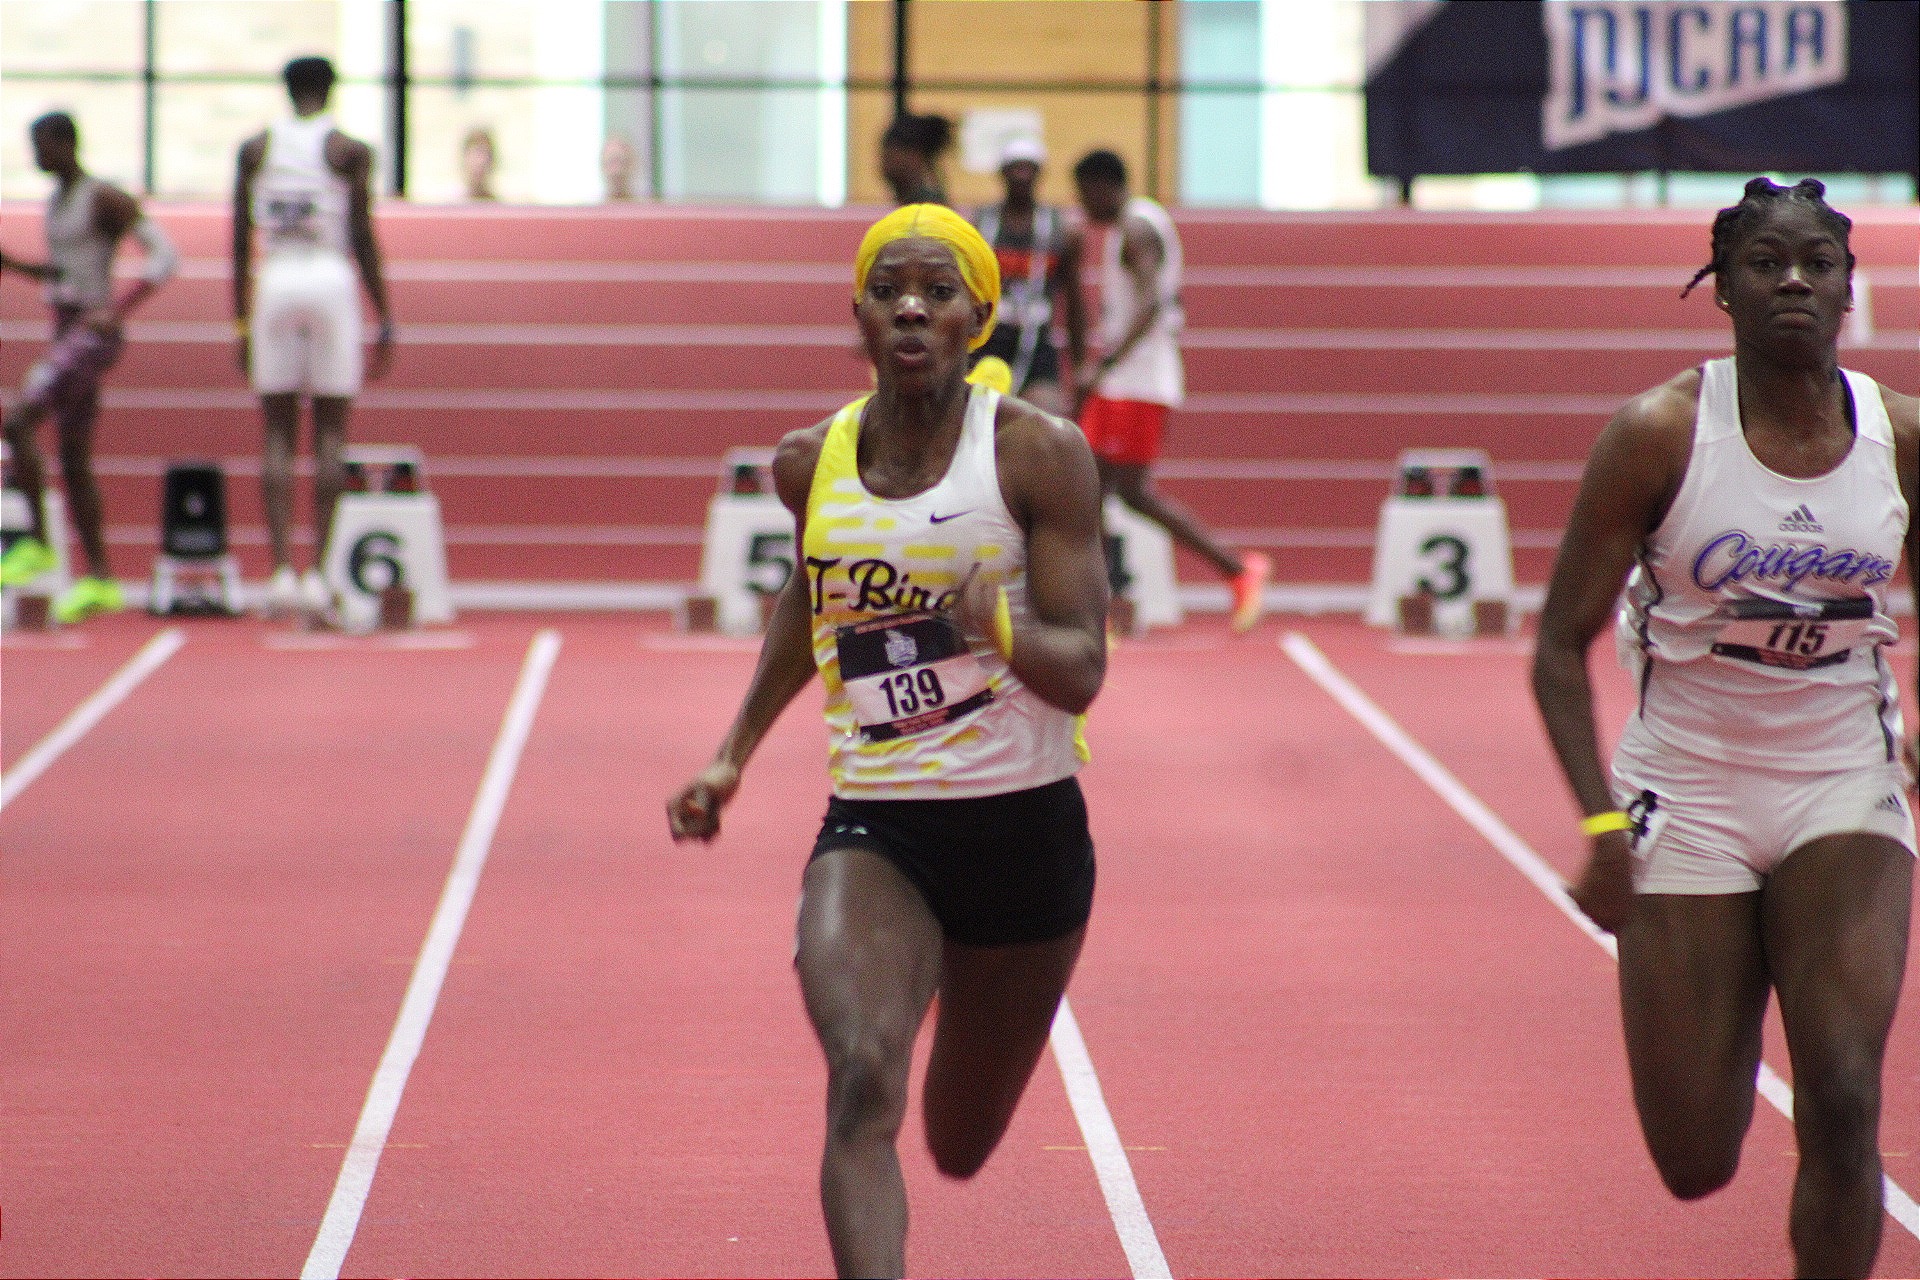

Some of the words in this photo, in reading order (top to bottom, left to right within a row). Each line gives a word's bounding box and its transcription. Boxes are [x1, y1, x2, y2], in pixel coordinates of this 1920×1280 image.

[1569, 2, 1824, 121] NJCAA
[1778, 523, 1824, 533] adidas
[350, 529, 405, 596] 6
[745, 533, 793, 595] 5
[1415, 534, 1469, 602] 3
[1692, 530, 1895, 595] Cougars
[1767, 622, 1829, 655] 115
[879, 668, 945, 716] 139
